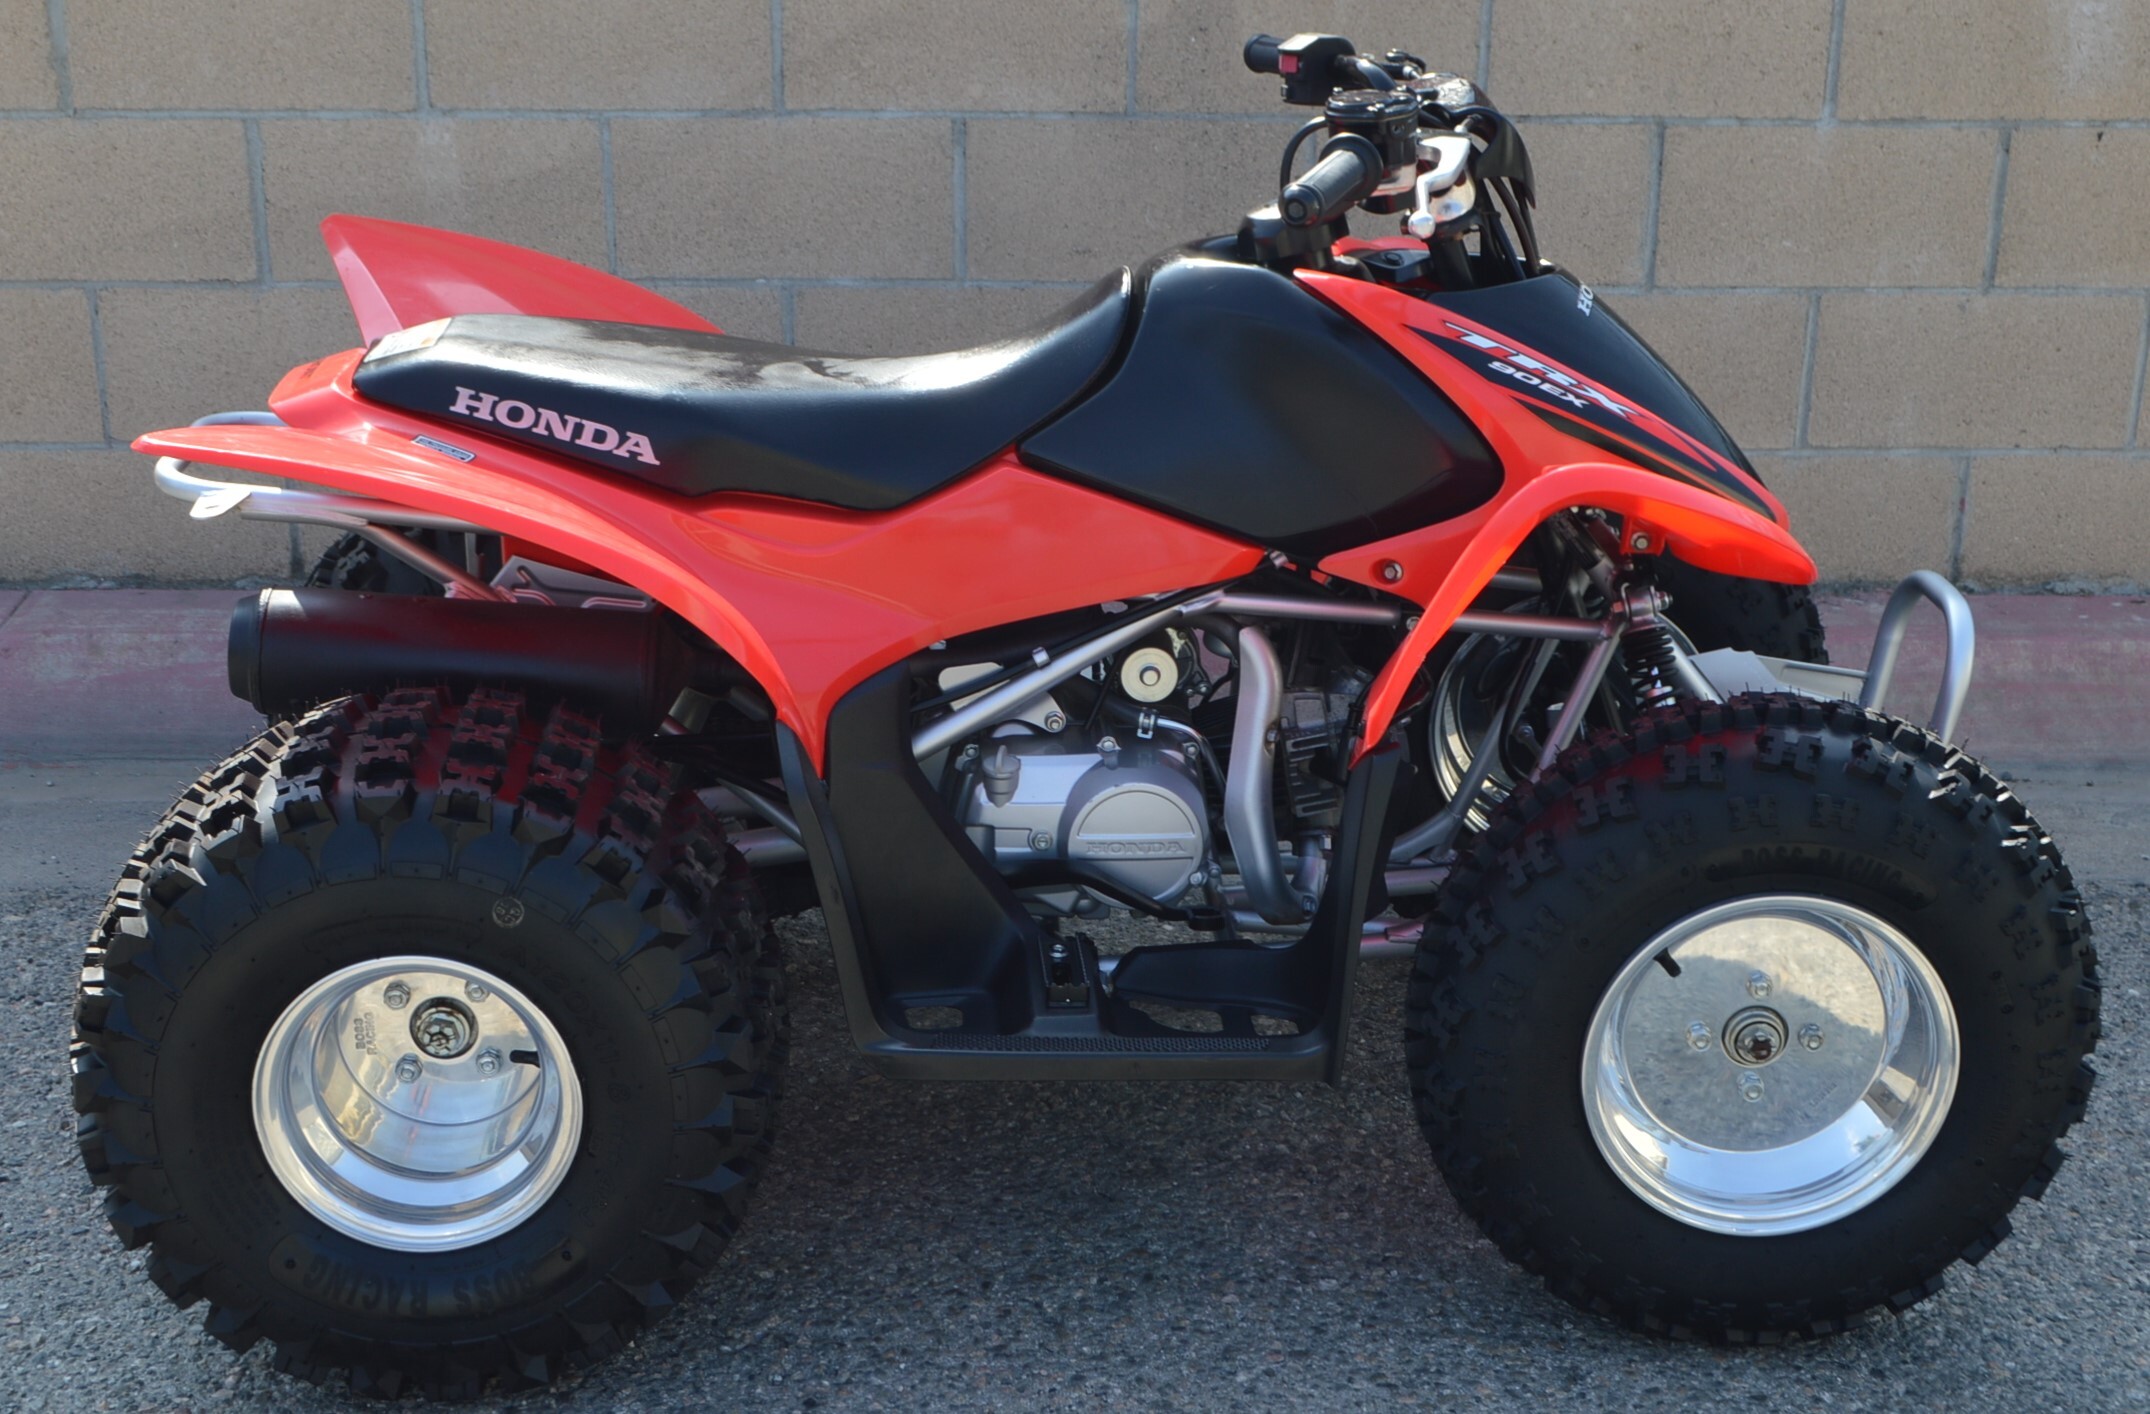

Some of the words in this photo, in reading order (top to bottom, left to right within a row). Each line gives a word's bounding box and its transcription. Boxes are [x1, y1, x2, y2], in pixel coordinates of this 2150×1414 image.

[1443, 321, 1641, 419] TRX
[1487, 360, 1591, 409] 90EX
[449, 386, 661, 466] HONDA
[1086, 841, 1187, 856] HONDA
[302, 1253, 429, 1316] RACING
[453, 1258, 534, 1315] BOSS
